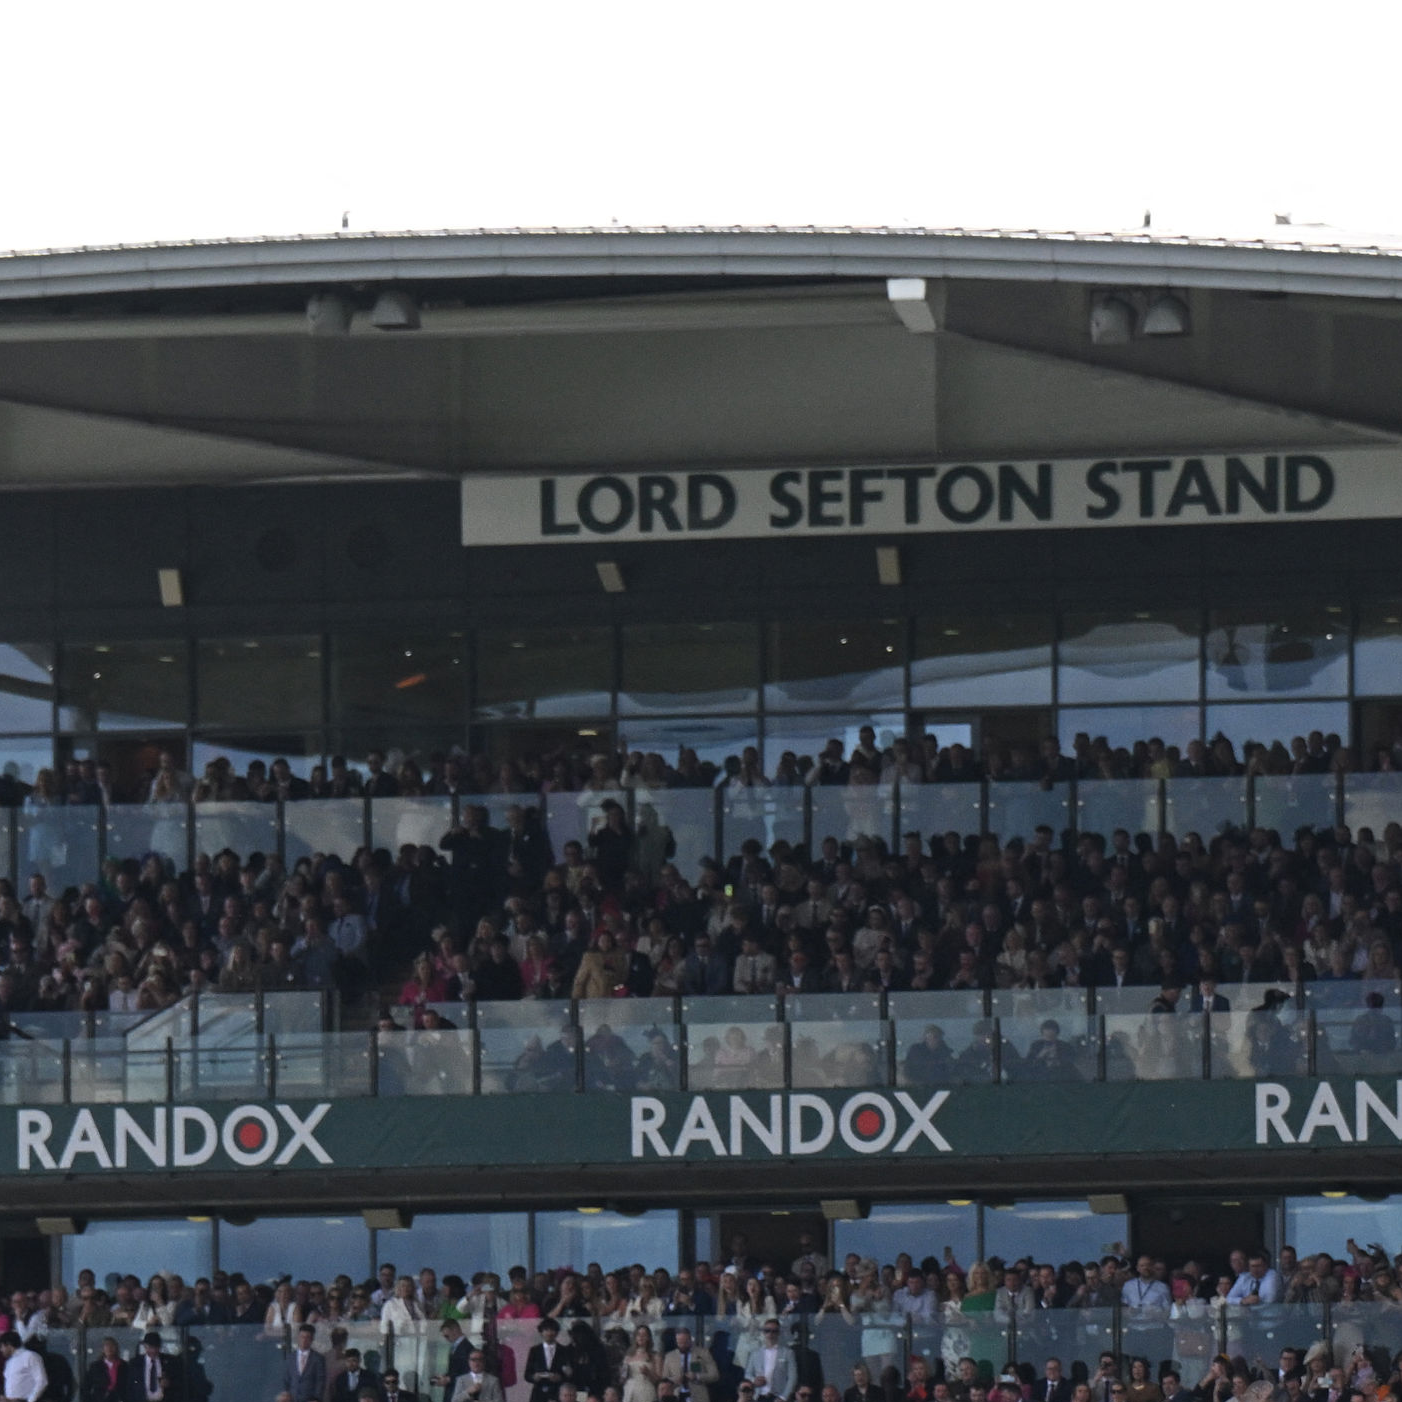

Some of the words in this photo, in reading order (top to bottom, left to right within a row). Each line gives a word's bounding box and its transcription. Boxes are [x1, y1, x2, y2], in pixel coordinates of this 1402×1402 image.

[540, 472, 736, 536] LORD
[769, 463, 1054, 529] SEFTON
[1086, 454, 1335, 520] STAND
[19, 1105, 332, 1169] RANDOX
[633, 1092, 951, 1156] RANDOX
